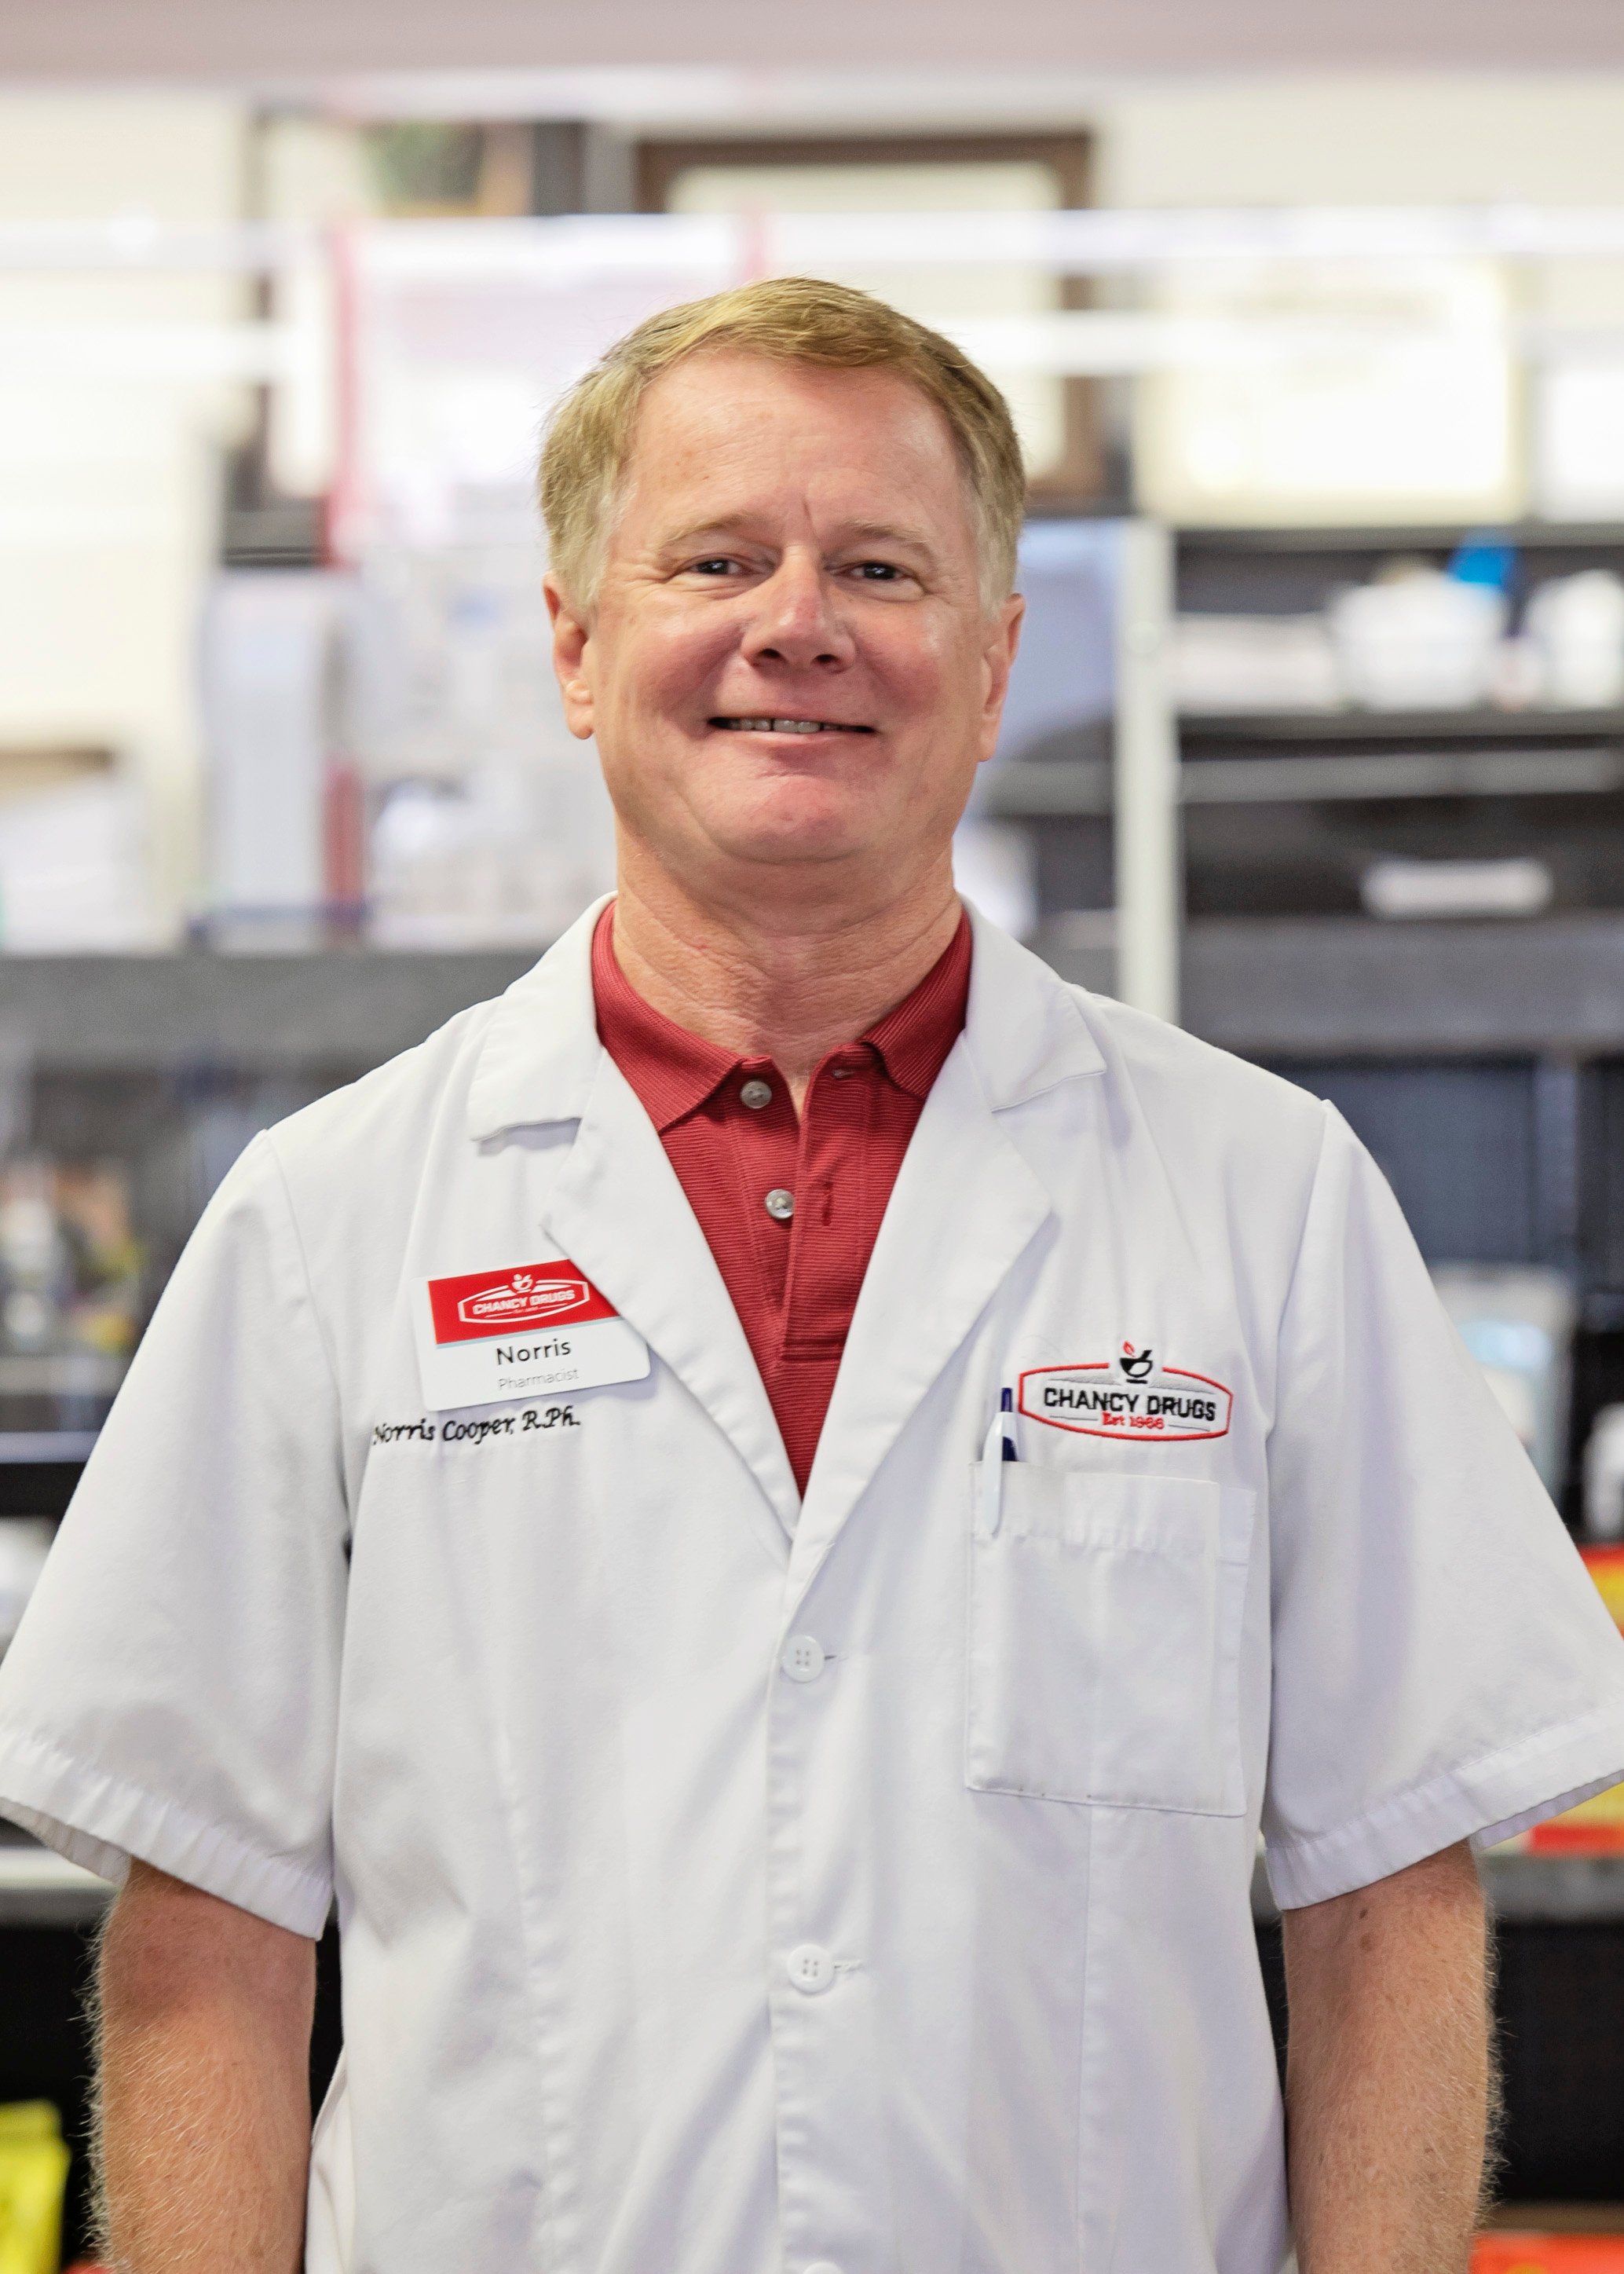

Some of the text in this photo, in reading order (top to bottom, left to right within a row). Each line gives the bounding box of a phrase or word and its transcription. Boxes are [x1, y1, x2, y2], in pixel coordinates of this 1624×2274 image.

[473, 1297, 528, 1314] CHANCY
[529, 1290, 576, 1305] DRUGS
[496, 1338, 572, 1365] Norris
[498, 1368, 580, 1390] Pharmacist
[1044, 1387, 1216, 1421] CHANCY DRUGS
[373, 1418, 435, 1445] Norris
[442, 1417, 515, 1445] Cooper,
